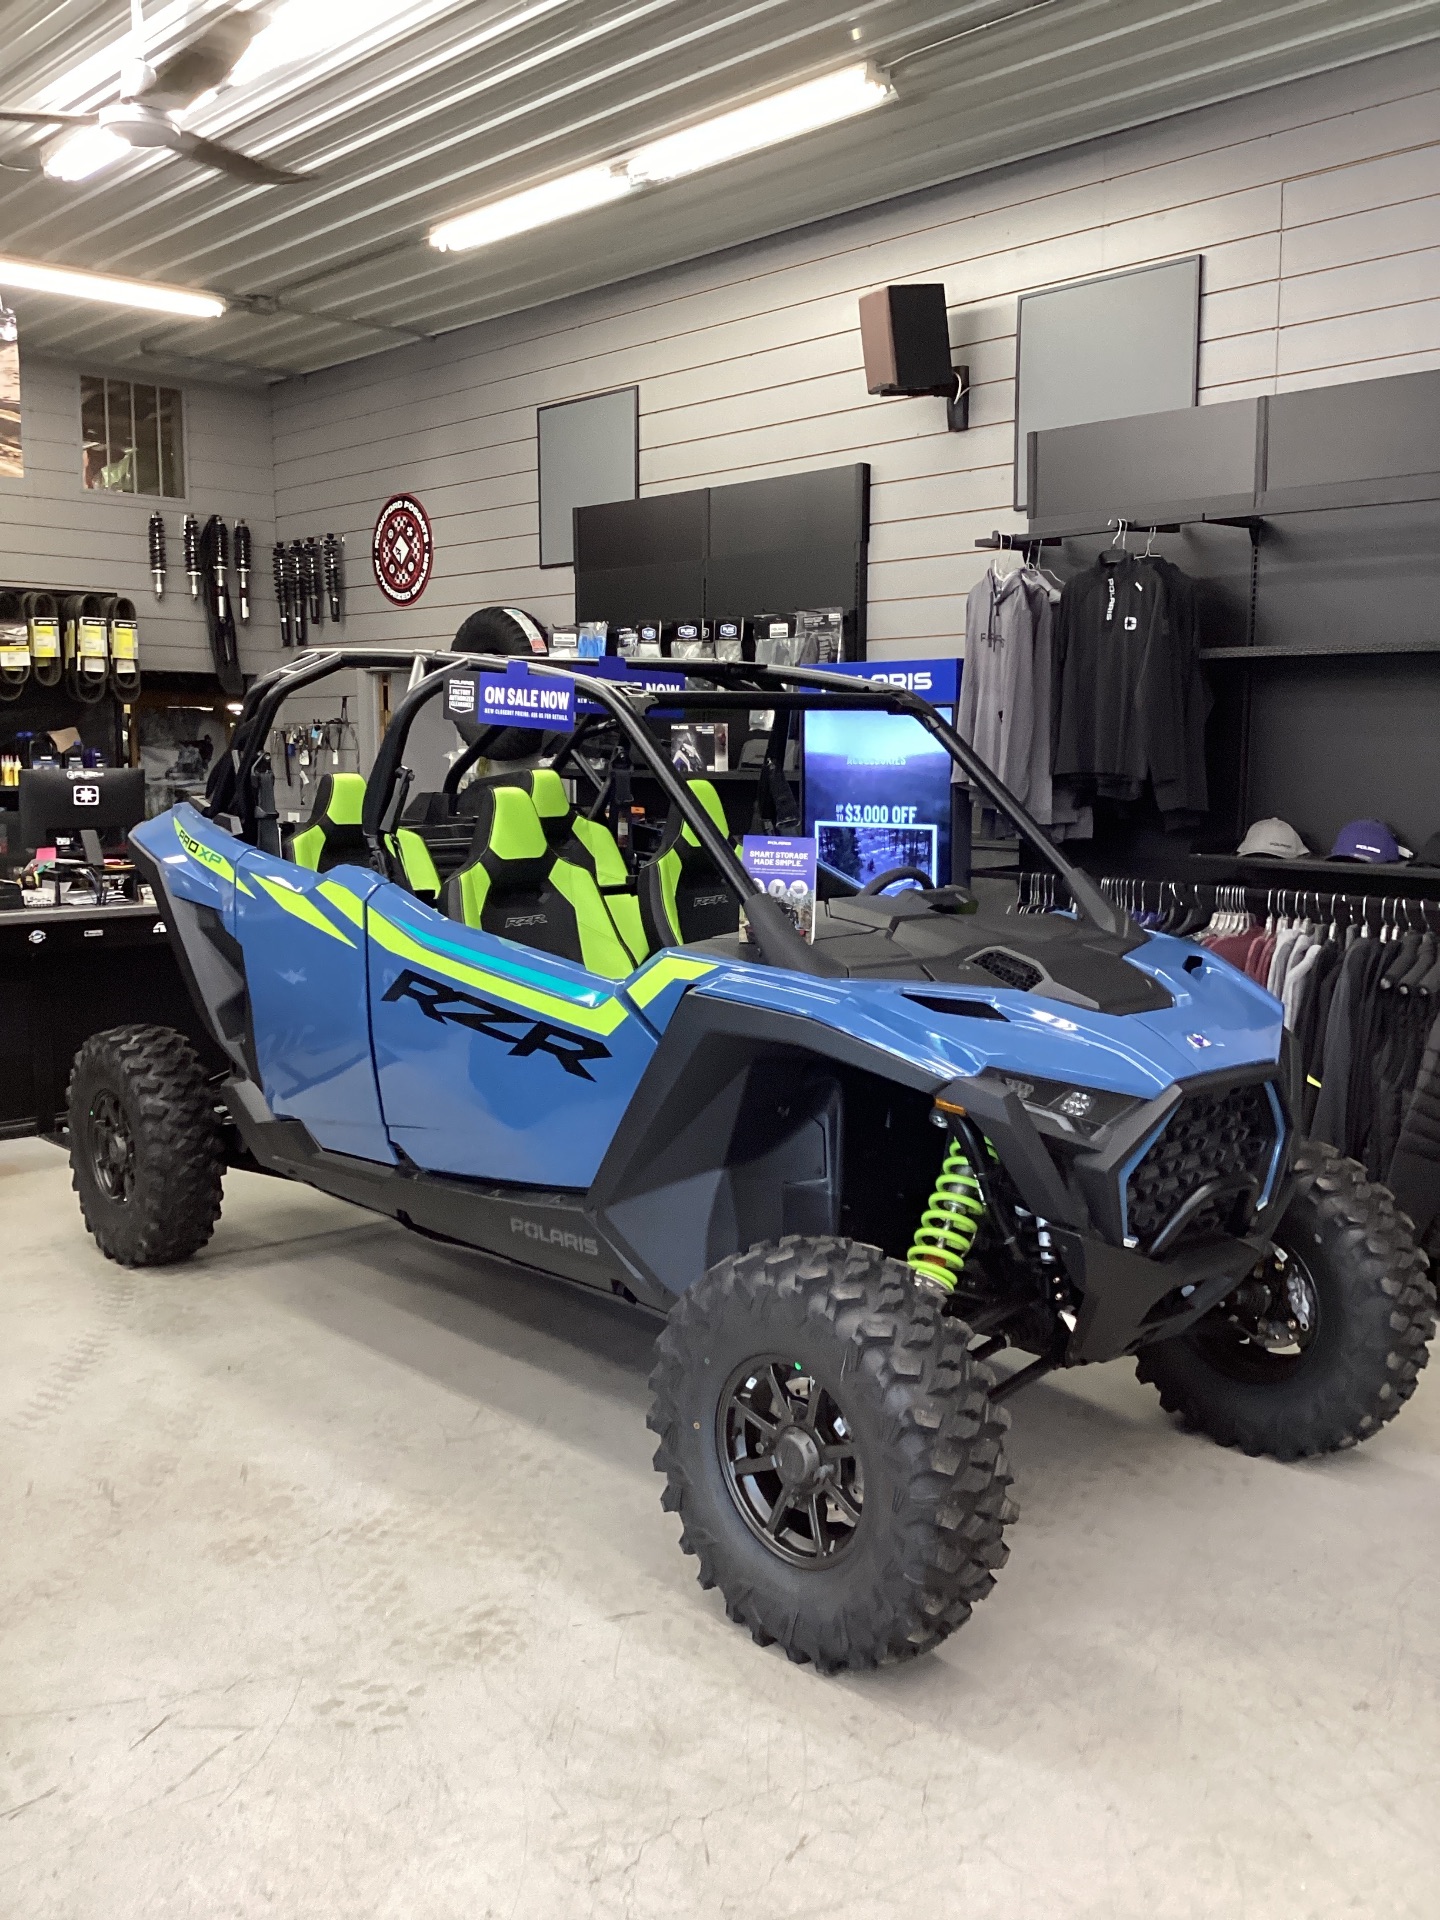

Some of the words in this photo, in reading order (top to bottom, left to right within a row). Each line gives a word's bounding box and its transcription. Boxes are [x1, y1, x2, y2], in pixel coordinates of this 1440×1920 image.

[374, 500, 403, 549] ROCKFORD
[403, 500, 430, 543] FOSGATE
[375, 559, 411, 601] AUTHORIZED
[410, 552, 430, 596] DEALER
[1106, 577, 1116, 621] POLARIS
[484, 686, 505, 704] ON
[507, 688, 539, 707] SALE
[540, 689, 570, 711] NOW
[835, 804, 844, 816] UP
[845, 803, 889, 824] $3,000
[891, 806, 918, 824] OFF
[197, 847, 223, 864] XP
[749, 850, 775, 859] SMART
[775, 851, 809, 861] STORAGE
[753, 858, 774, 866] MADE
[774, 859, 804, 868] SIMPLE.
[504, 913, 549, 929] RZR
[380, 968, 614, 1083] RZR
[509, 1217, 599, 1256] POLARIS
